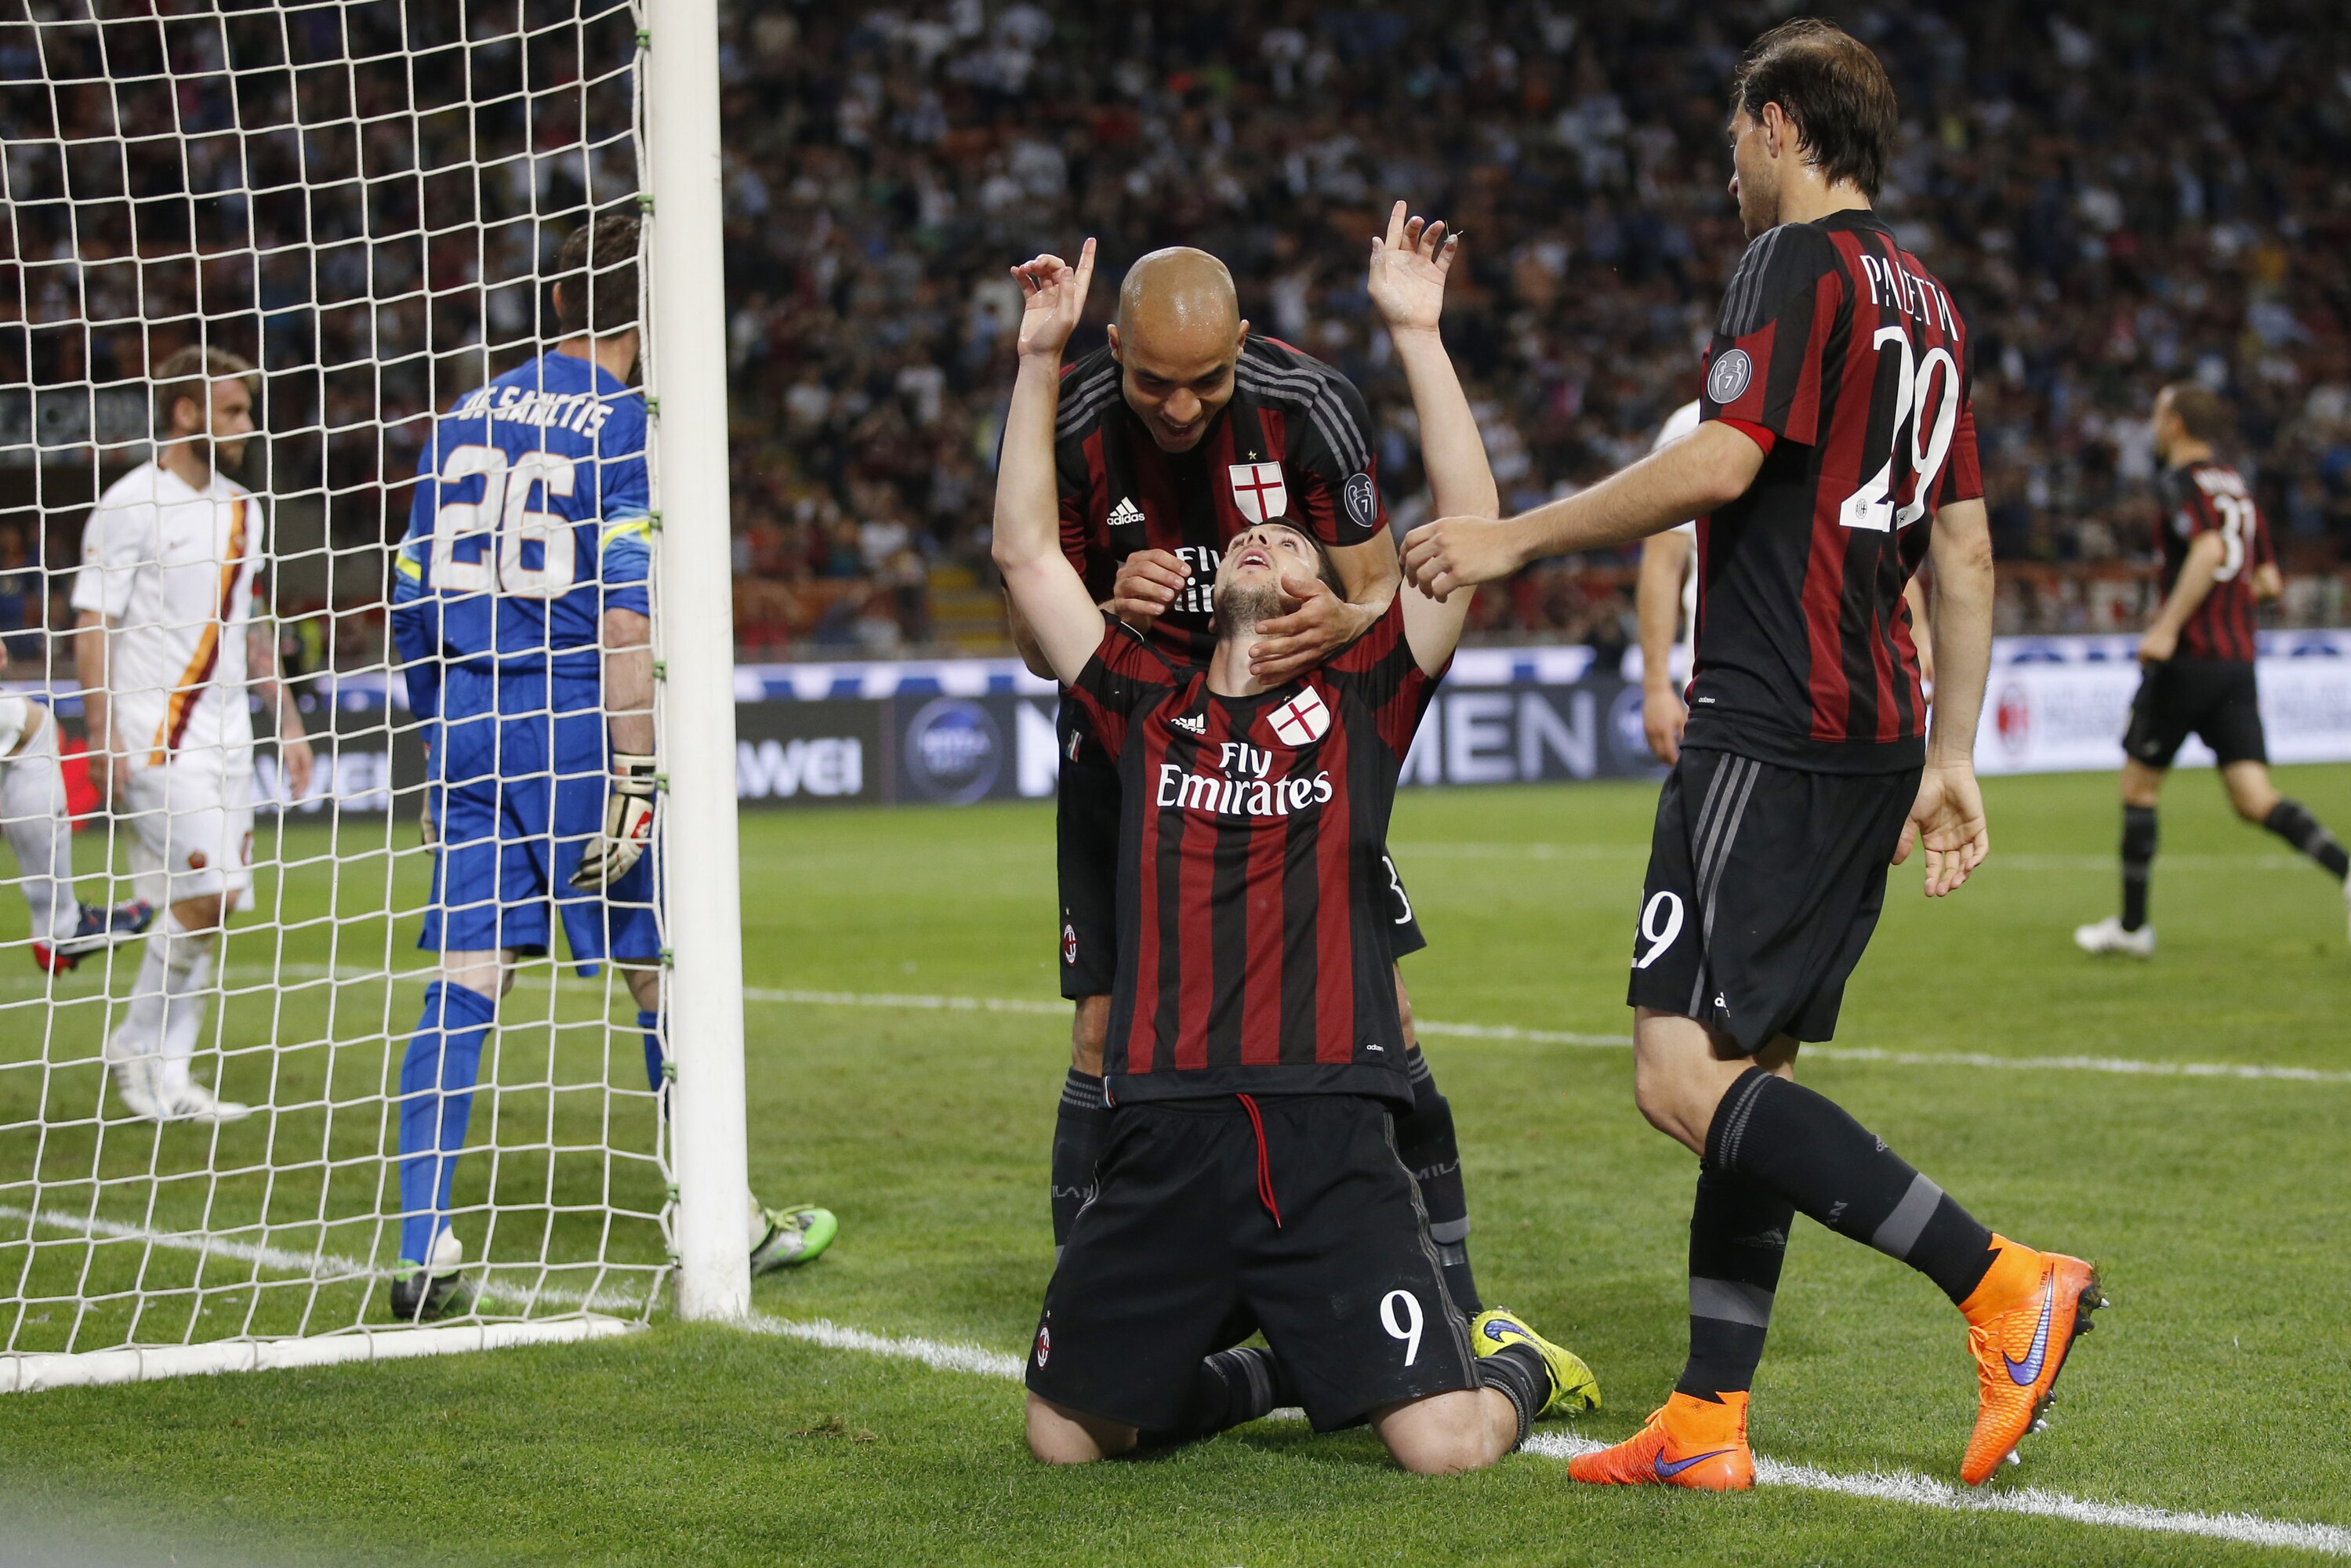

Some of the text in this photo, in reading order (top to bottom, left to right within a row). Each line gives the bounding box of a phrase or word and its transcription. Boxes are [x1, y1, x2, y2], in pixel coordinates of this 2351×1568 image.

[1725, 375, 1734, 390] 7
[492, 386, 615, 439] SANCTIS
[1839, 325, 1959, 533] 29
[429, 444, 577, 600] 26
[1106, 512, 1146, 526] adidas
[1361, 499, 1369, 514] 7
[1218, 742, 1273, 779] Fly
[1156, 764, 1333, 817] Emirates
[1631, 887, 1685, 969] 9
[1380, 1290, 1424, 1367] 9
